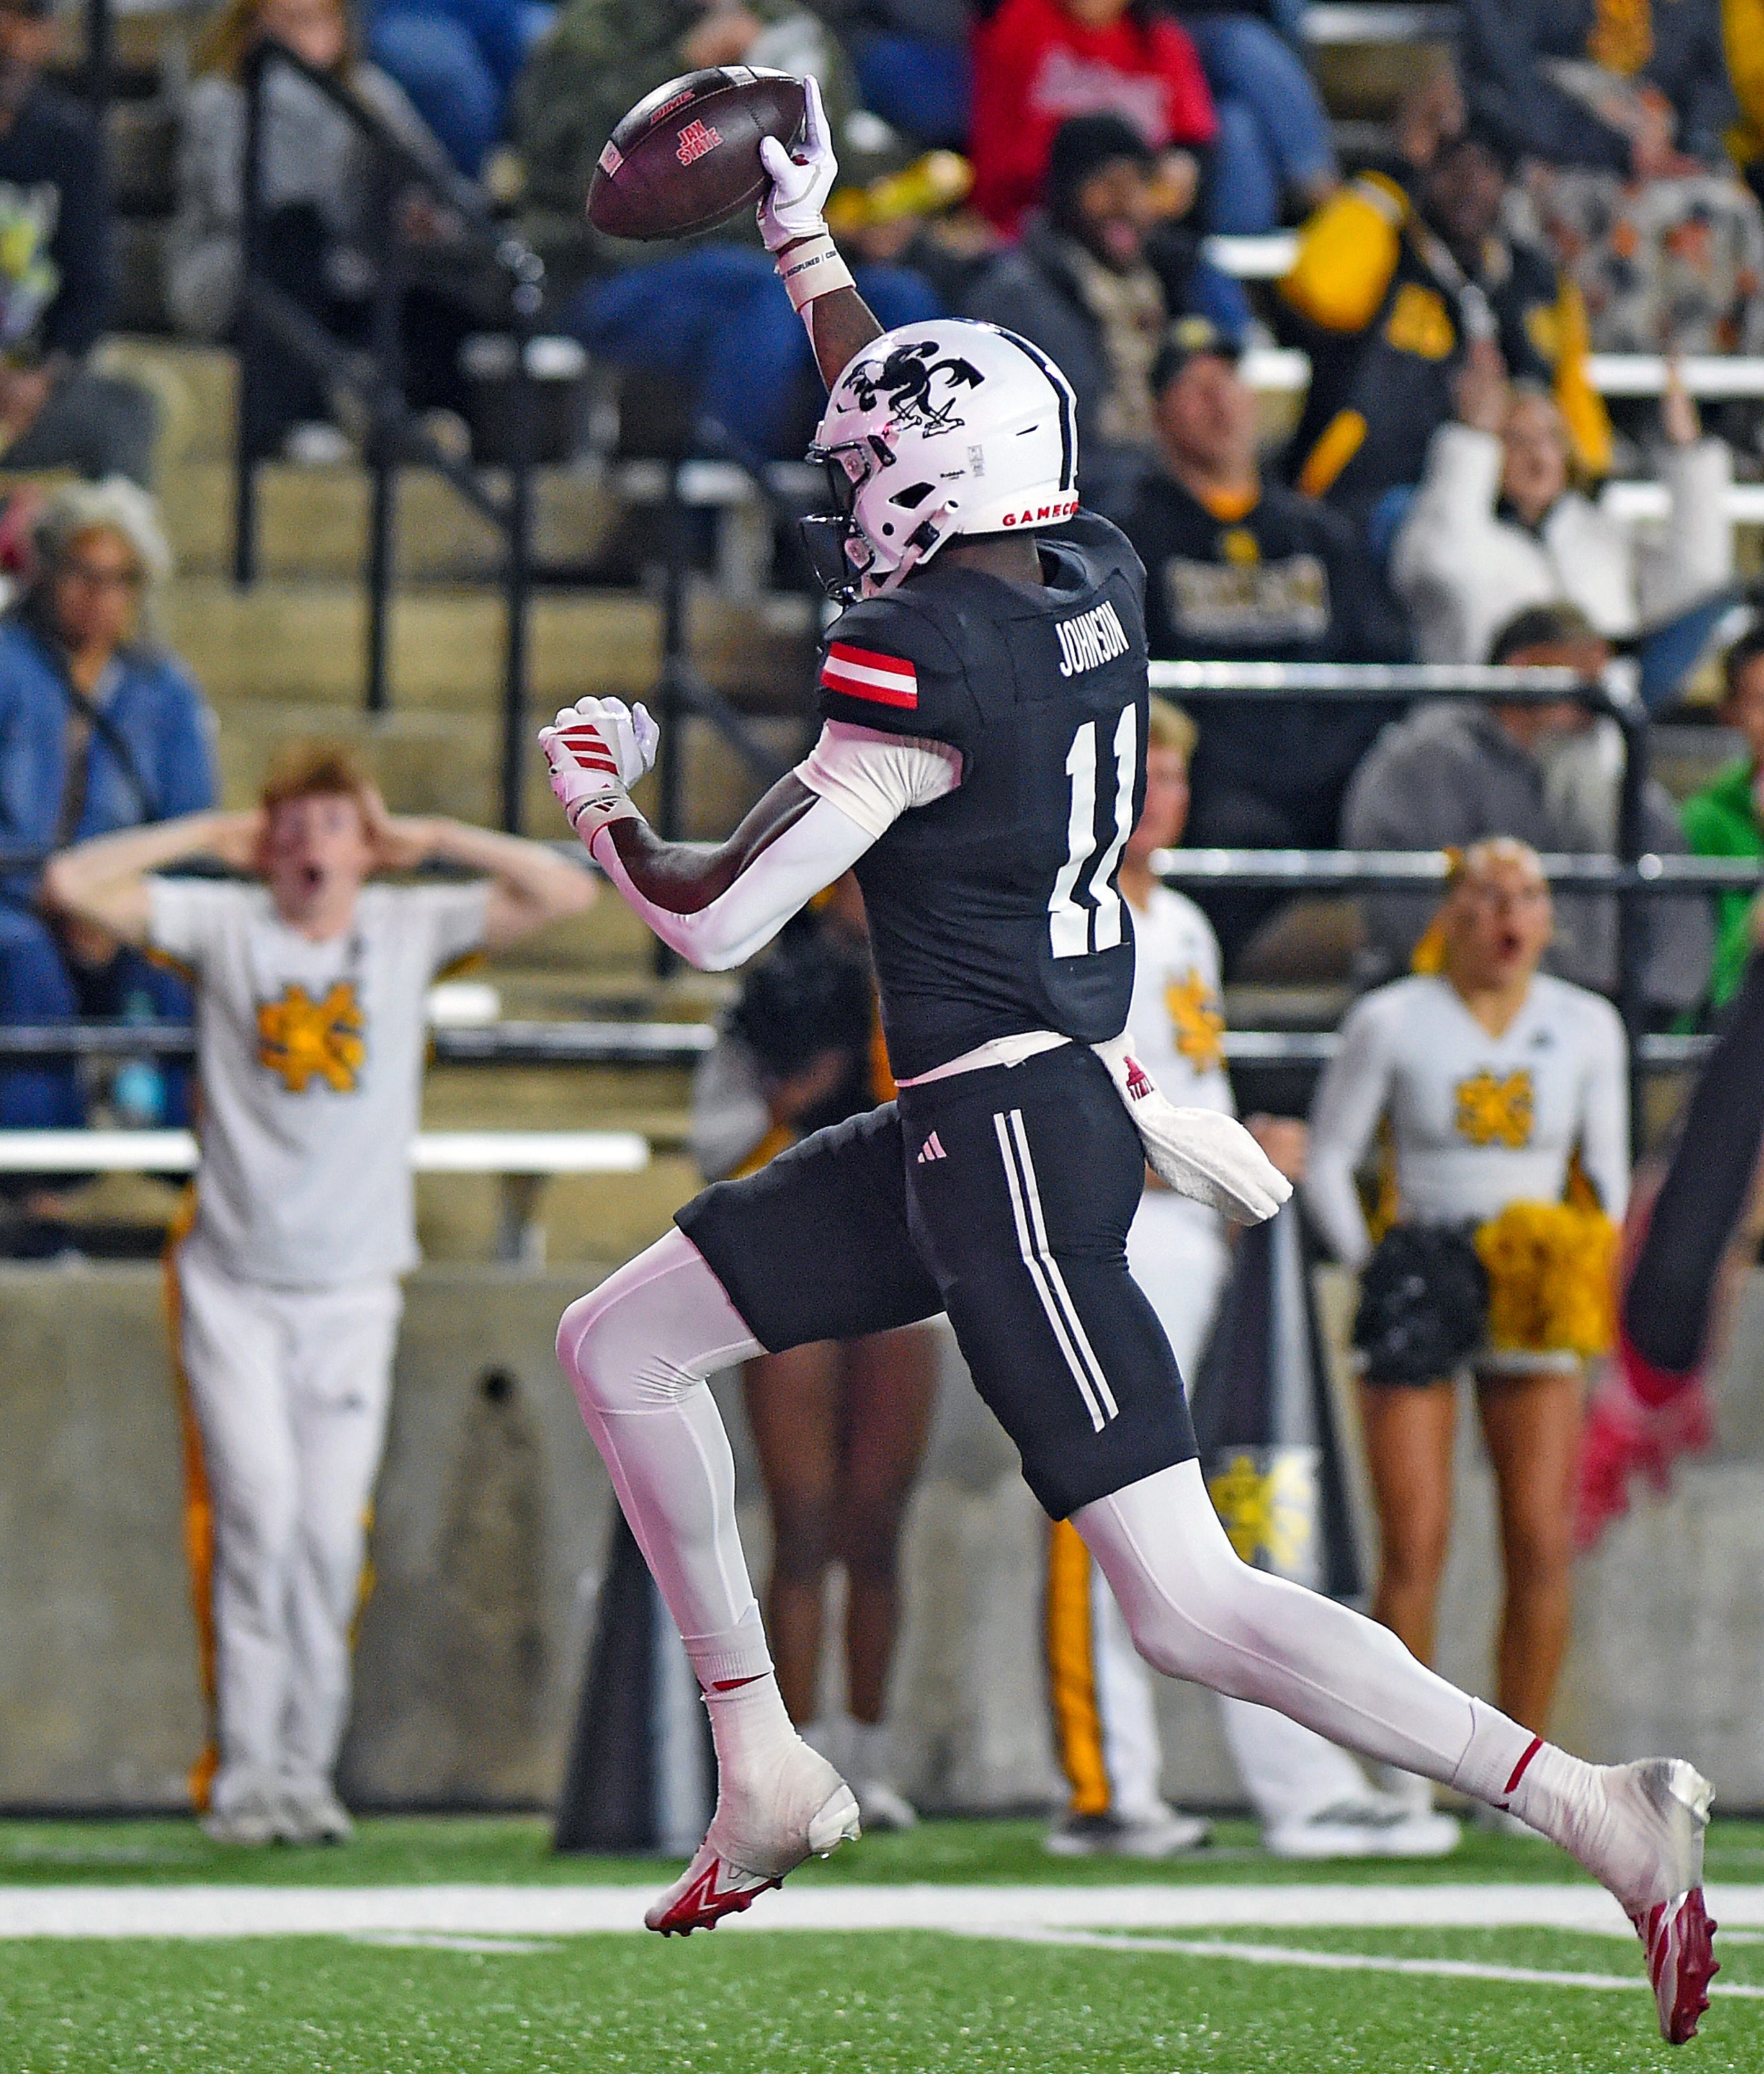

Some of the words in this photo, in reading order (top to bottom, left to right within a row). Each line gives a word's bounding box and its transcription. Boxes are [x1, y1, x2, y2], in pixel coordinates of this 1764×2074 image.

[677, 118, 708, 147] JAX
[677, 127, 724, 166] STATE
[1055, 600, 1130, 677] JOHNSON
[1048, 702, 1136, 959] 11
